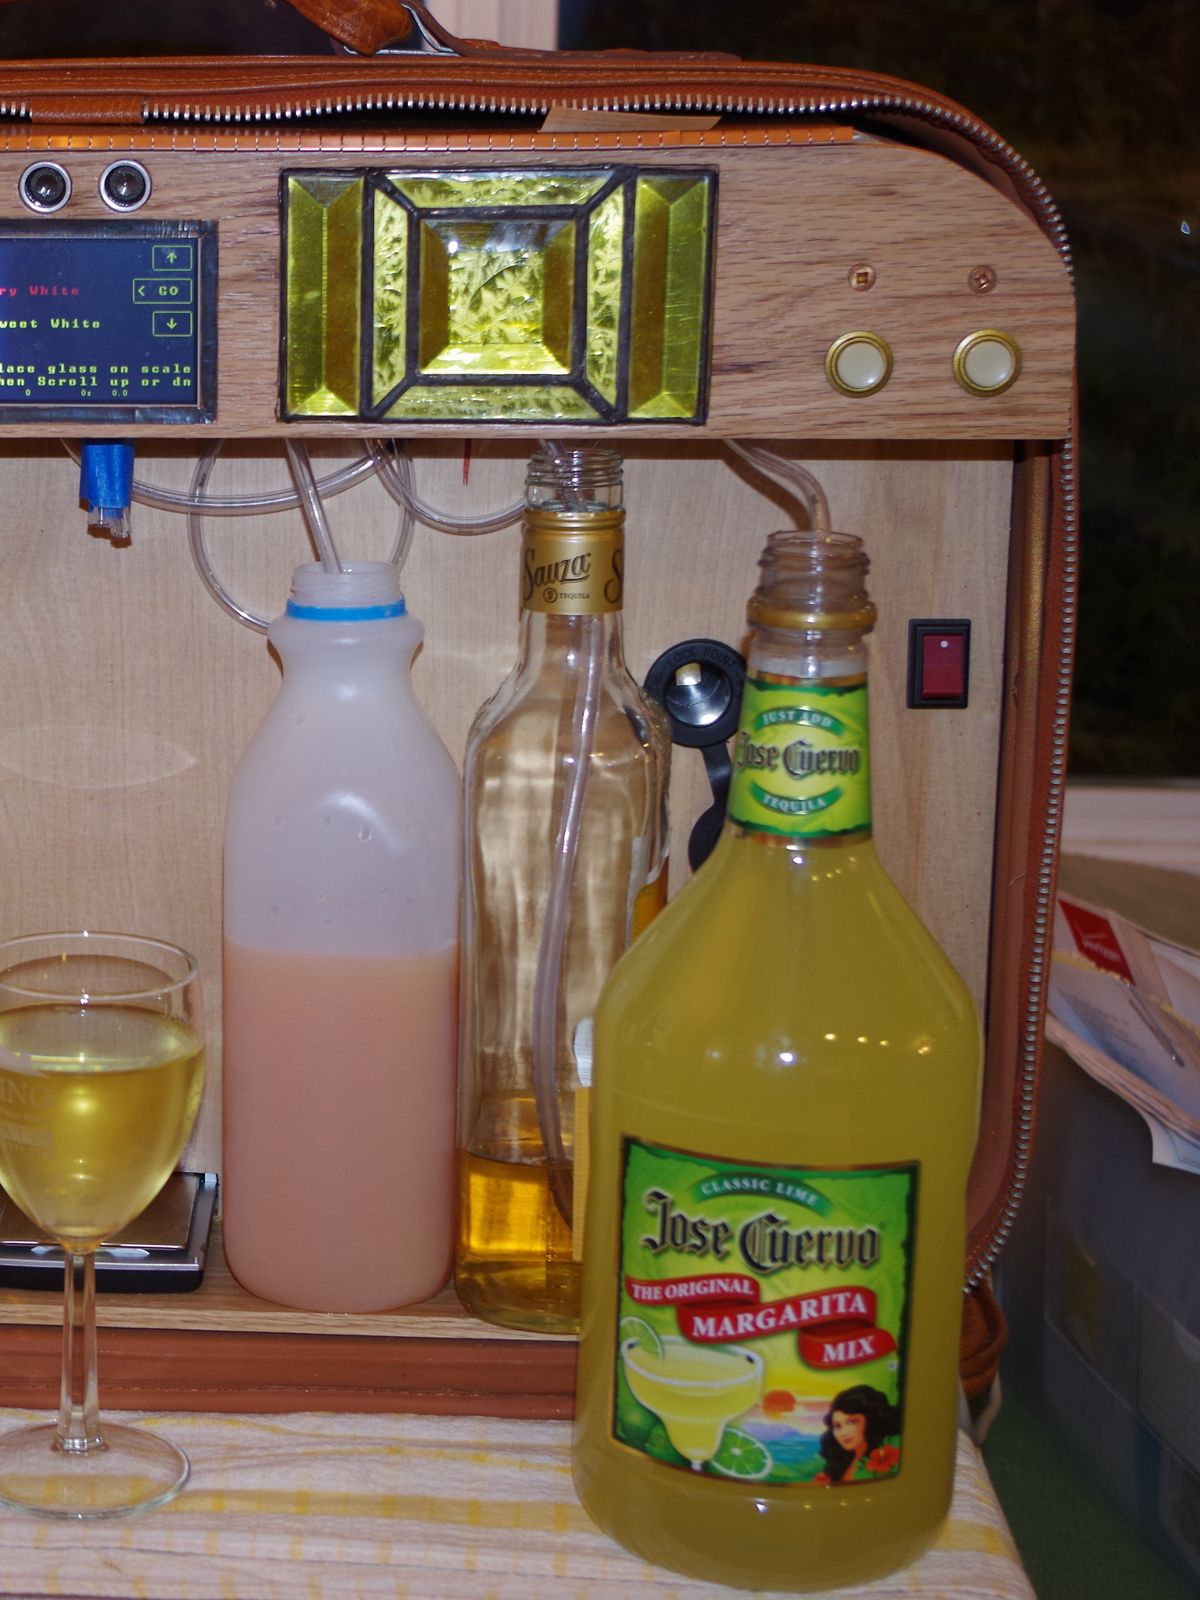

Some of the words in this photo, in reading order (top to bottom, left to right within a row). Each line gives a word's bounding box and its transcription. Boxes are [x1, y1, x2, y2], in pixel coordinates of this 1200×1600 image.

[29, 285, 80, 296] White
[158, 286, 179, 296] GO
[50, 318, 101, 329] White
[48, 363, 98, 376] glass
[110, 365, 129, 374] on
[141, 363, 192, 374] scale
[37, 376, 98, 387] Scroll
[110, 378, 129, 388] up
[141, 377, 161, 387] or
[173, 376, 192, 387] dn
[112, 388, 129, 397] 0.0
[523, 547, 592, 603] Sauza
[763, 711, 796, 725] JUST
[801, 712, 833, 728] ADD
[737, 730, 779, 770] Jose
[783, 739, 861, 780] Cuervo
[763, 794, 826, 812] TEQUILA
[700, 1175, 770, 1197] CLASSIC
[774, 1181, 818, 1207] LIME
[641, 1187, 734, 1261] Jose
[737, 1211, 881, 1275] Cuervo
[631, 1282, 665, 1301] THE
[664, 1277, 755, 1300] ORIGINAL
[692, 1291, 869, 1339] MARGARITA
[822, 1335, 877, 1364] MIX
